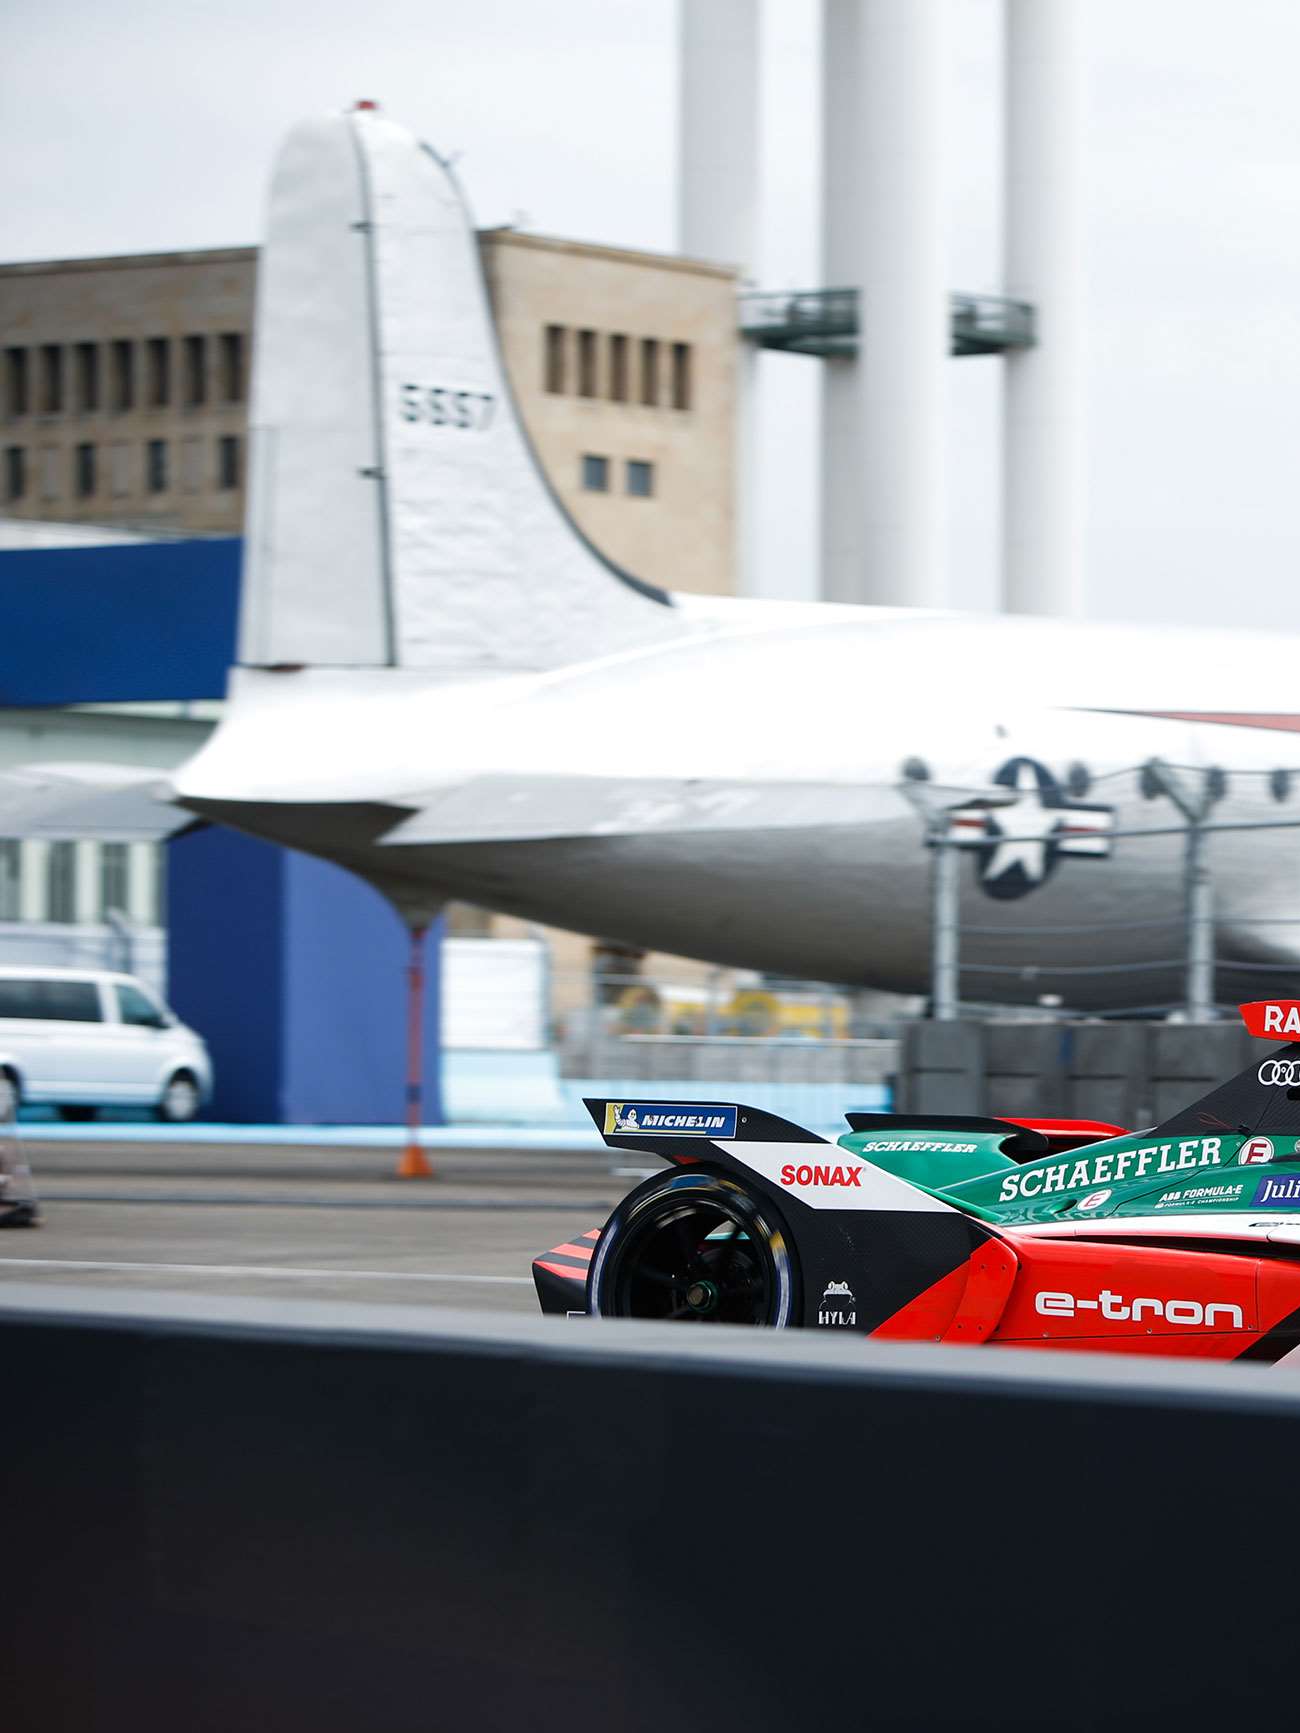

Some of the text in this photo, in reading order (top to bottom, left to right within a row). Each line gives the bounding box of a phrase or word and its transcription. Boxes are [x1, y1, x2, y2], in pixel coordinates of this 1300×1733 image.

[641, 1114, 726, 1128] MICHELIN
[862, 1141, 978, 1153] SCHAEFFLER
[780, 1164, 864, 1187] SONAX
[999, 1137, 1222, 1202] SCHAEFFLER
[1159, 1190, 1182, 1202] ABB
[1035, 1289, 1243, 1329] e-tron
[818, 1311, 856, 1325] HYLA
